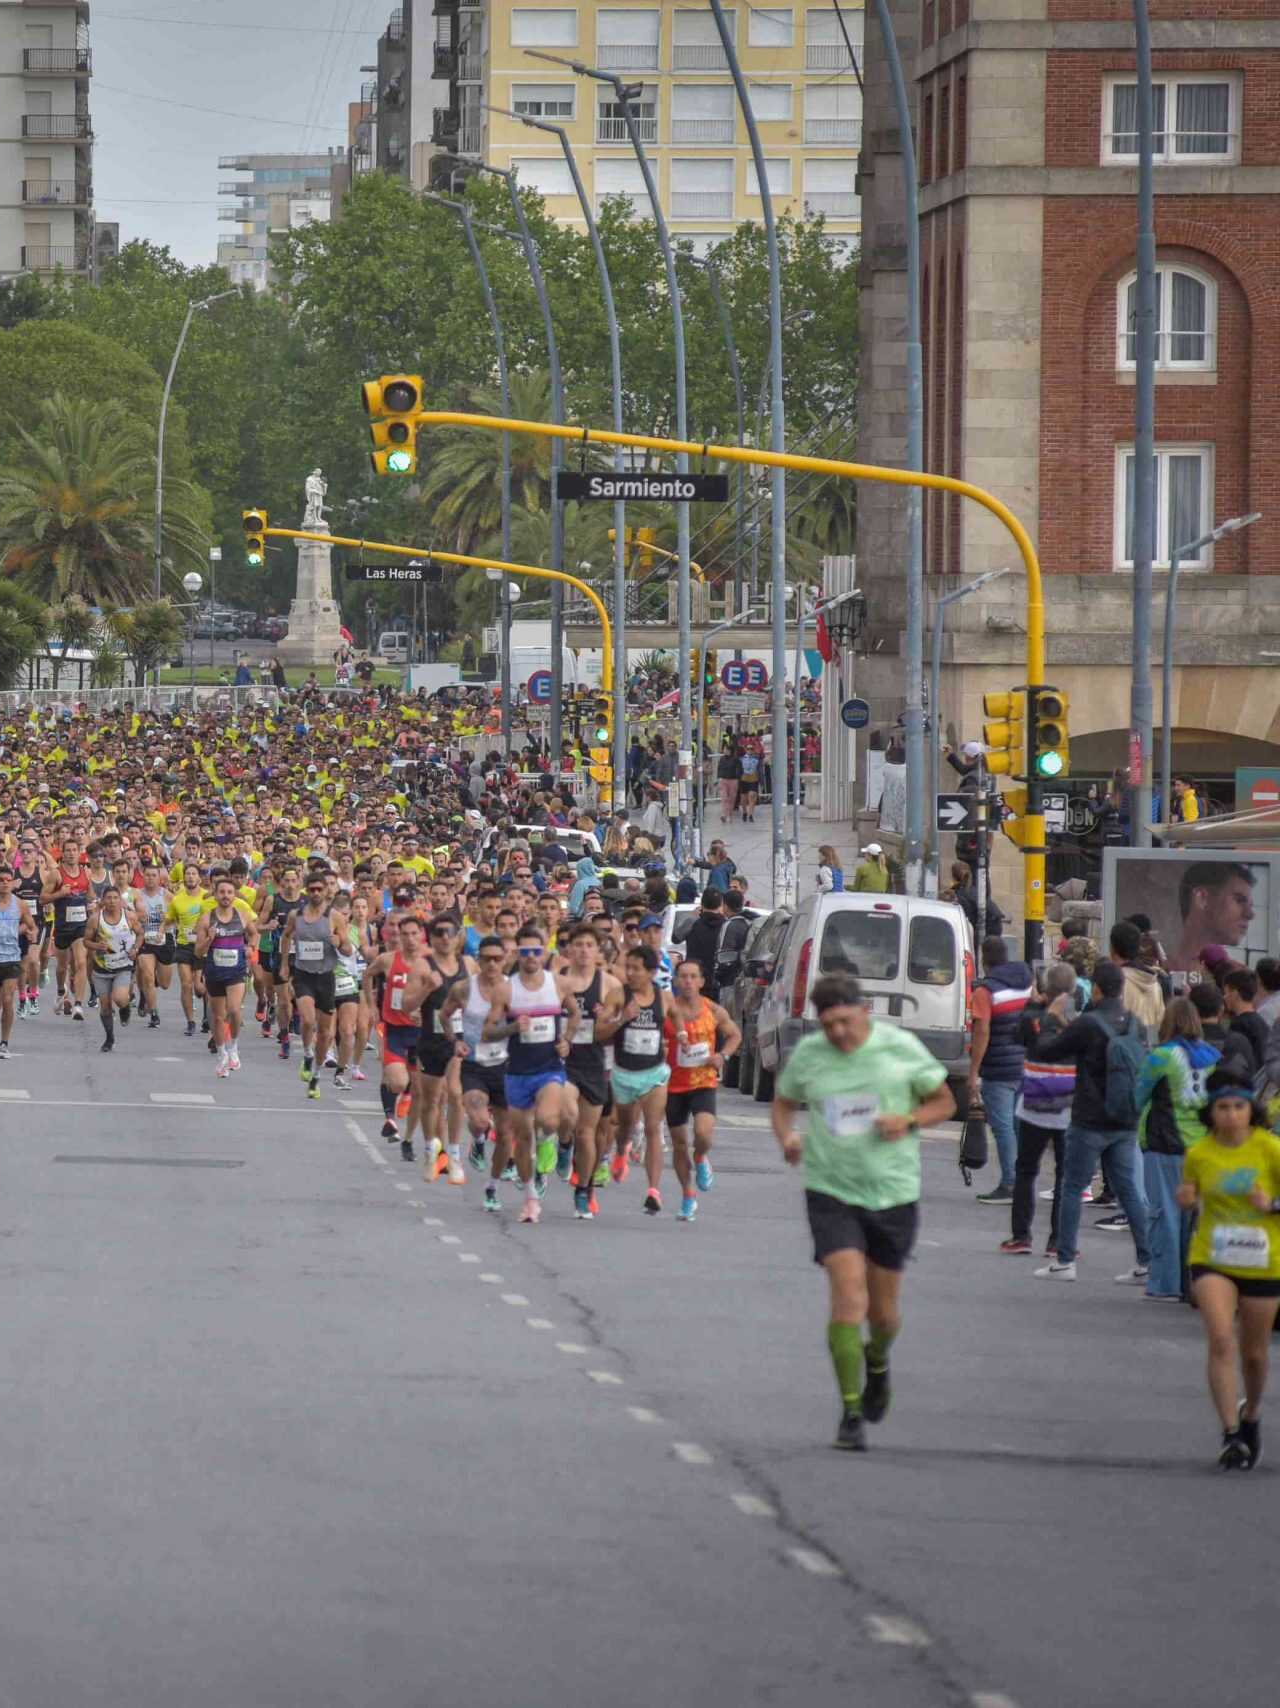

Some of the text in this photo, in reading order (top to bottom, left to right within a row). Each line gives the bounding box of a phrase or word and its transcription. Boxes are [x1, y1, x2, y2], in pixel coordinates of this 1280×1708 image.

[589, 476, 696, 498] Sarmiento
[365, 567, 422, 580] Las Heras
[728, 667, 742, 686] E
[748, 666, 761, 684] E
[537, 678, 552, 697] E
